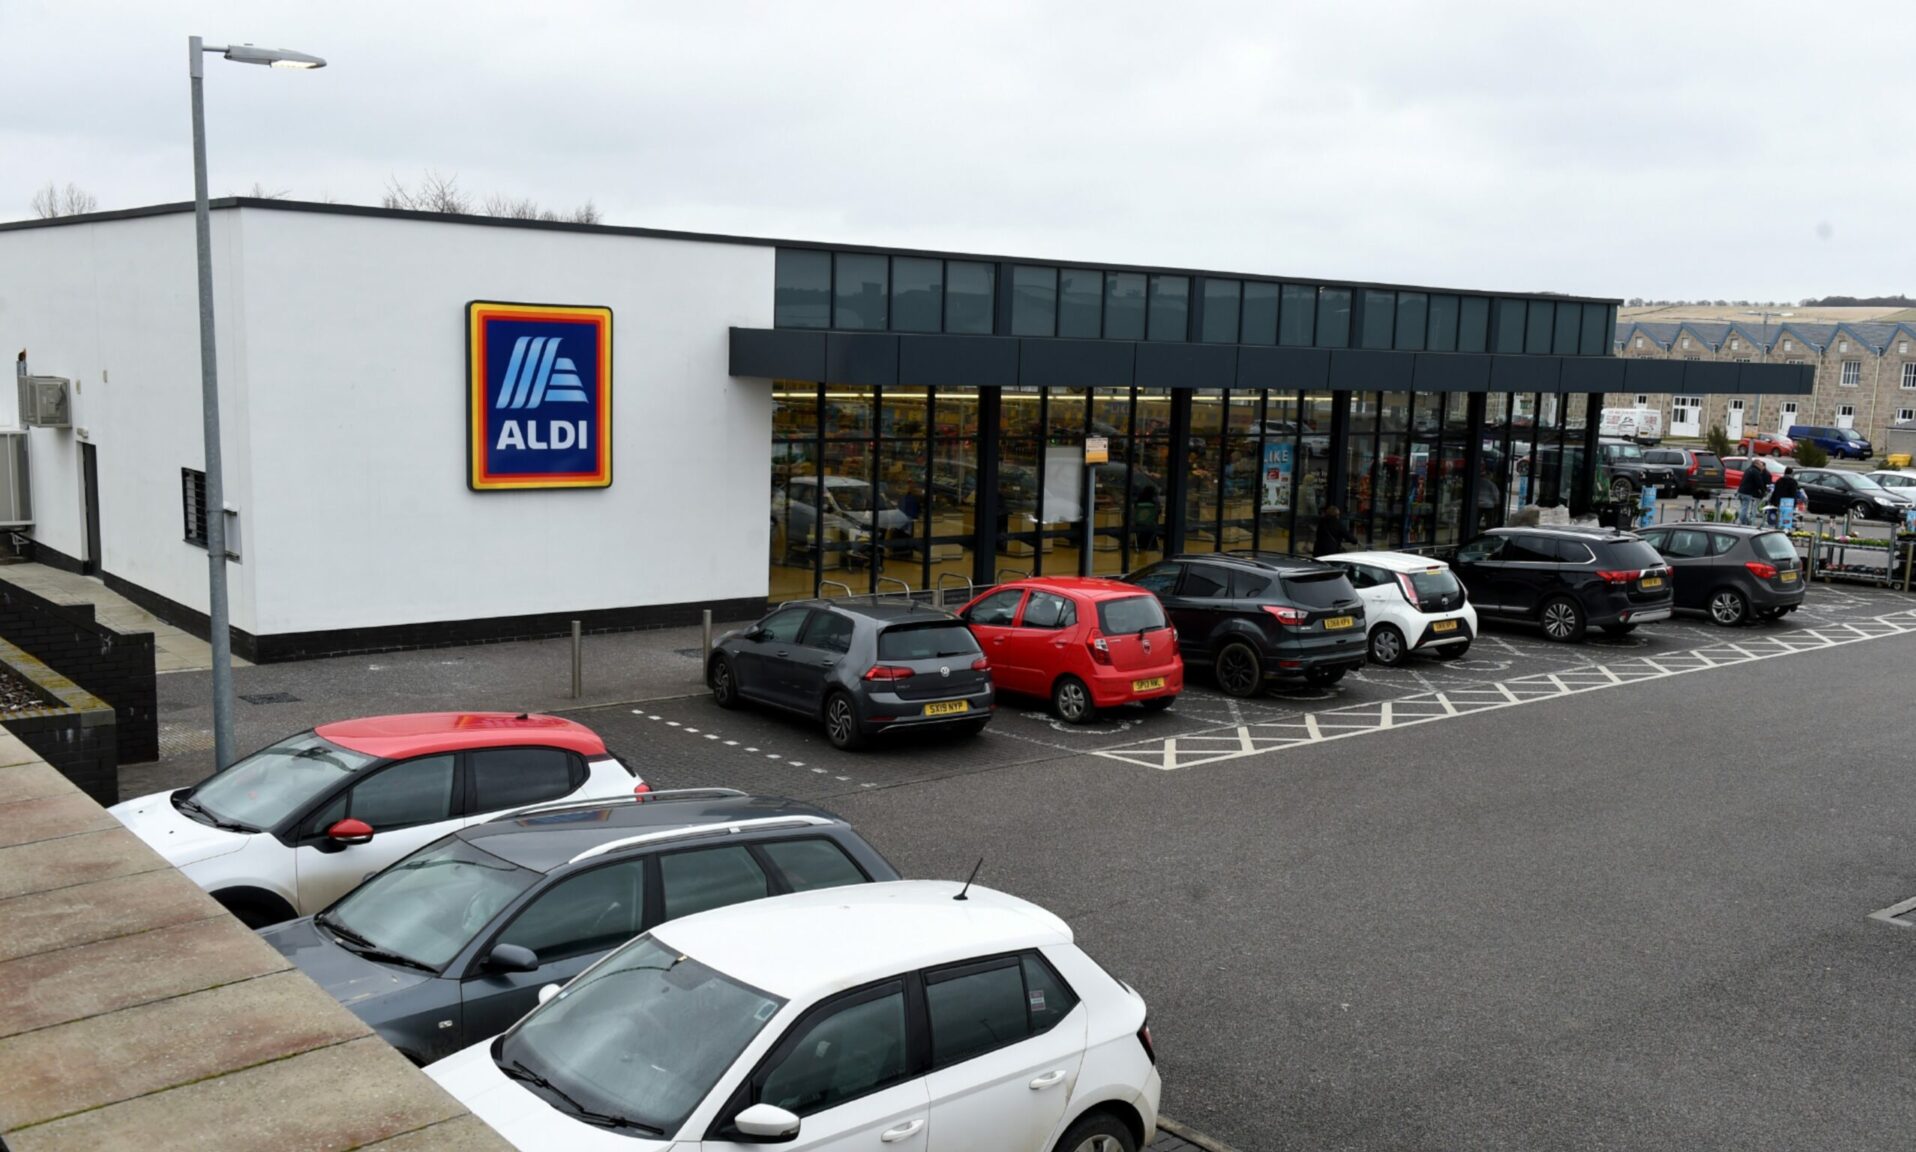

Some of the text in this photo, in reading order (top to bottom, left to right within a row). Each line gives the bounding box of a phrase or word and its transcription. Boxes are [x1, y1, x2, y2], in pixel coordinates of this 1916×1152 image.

[496, 419, 588, 450] ALDI
[929, 701, 963, 714] SX19 NYP
